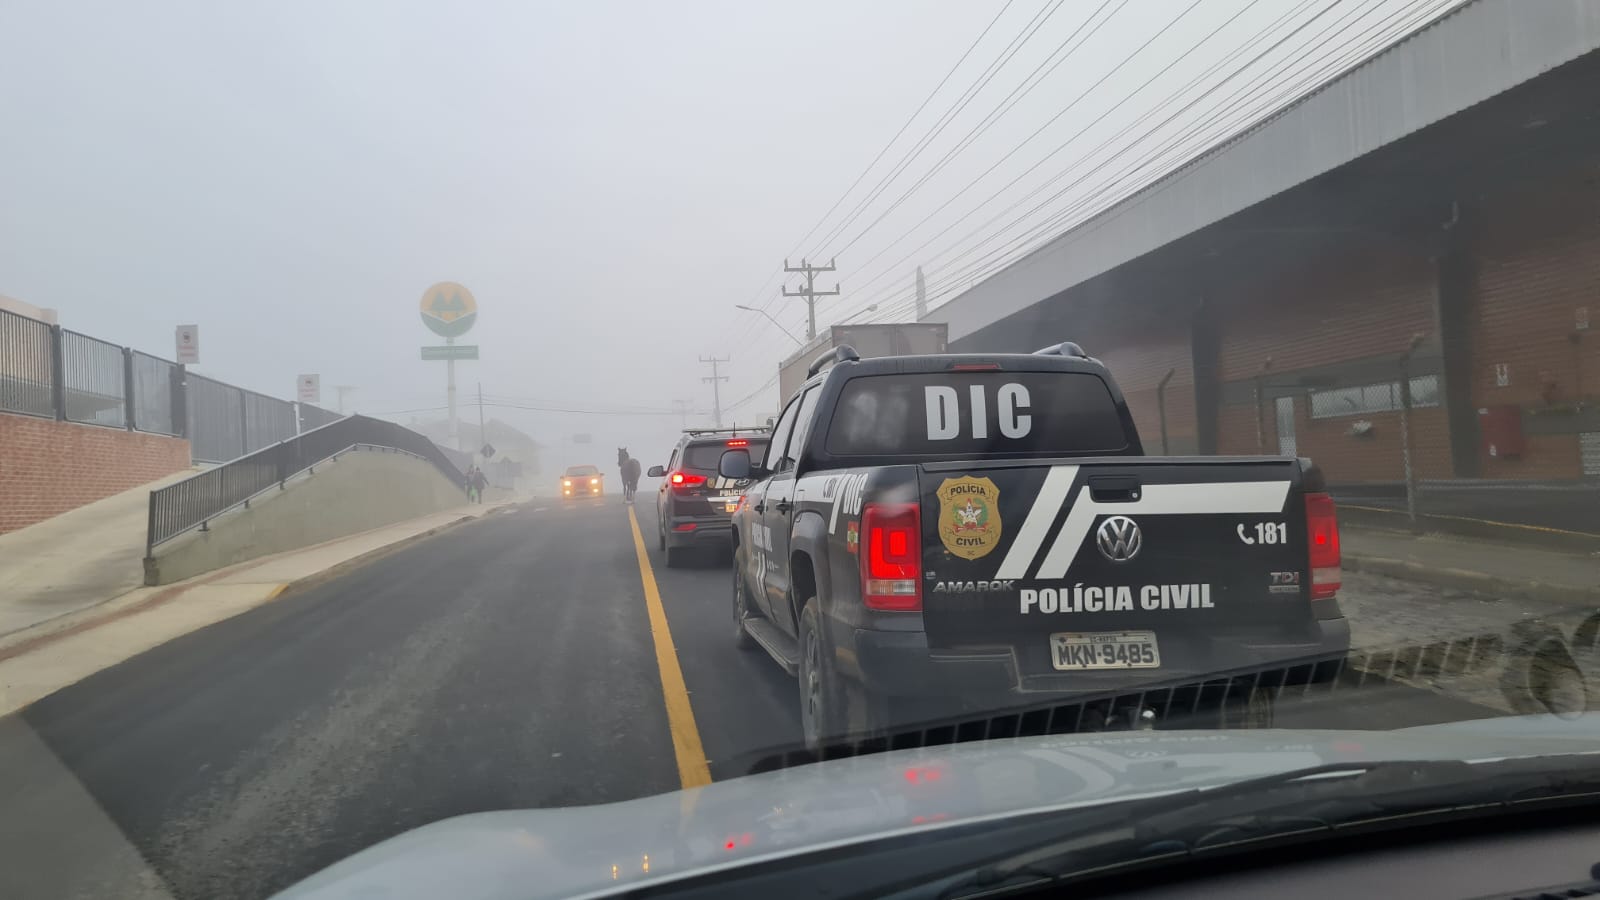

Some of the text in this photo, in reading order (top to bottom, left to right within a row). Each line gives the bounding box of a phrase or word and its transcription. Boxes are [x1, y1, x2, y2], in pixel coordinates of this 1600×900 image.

[924, 382, 1032, 441] DIC
[950, 484, 986, 496] POLÍCIA
[1254, 522, 1287, 545] 181
[955, 537, 986, 546] CIVIL
[1270, 571, 1300, 585] TDI
[932, 579, 1016, 594] AMAROK
[1019, 582, 1216, 615] POLÍCIA CIVIL
